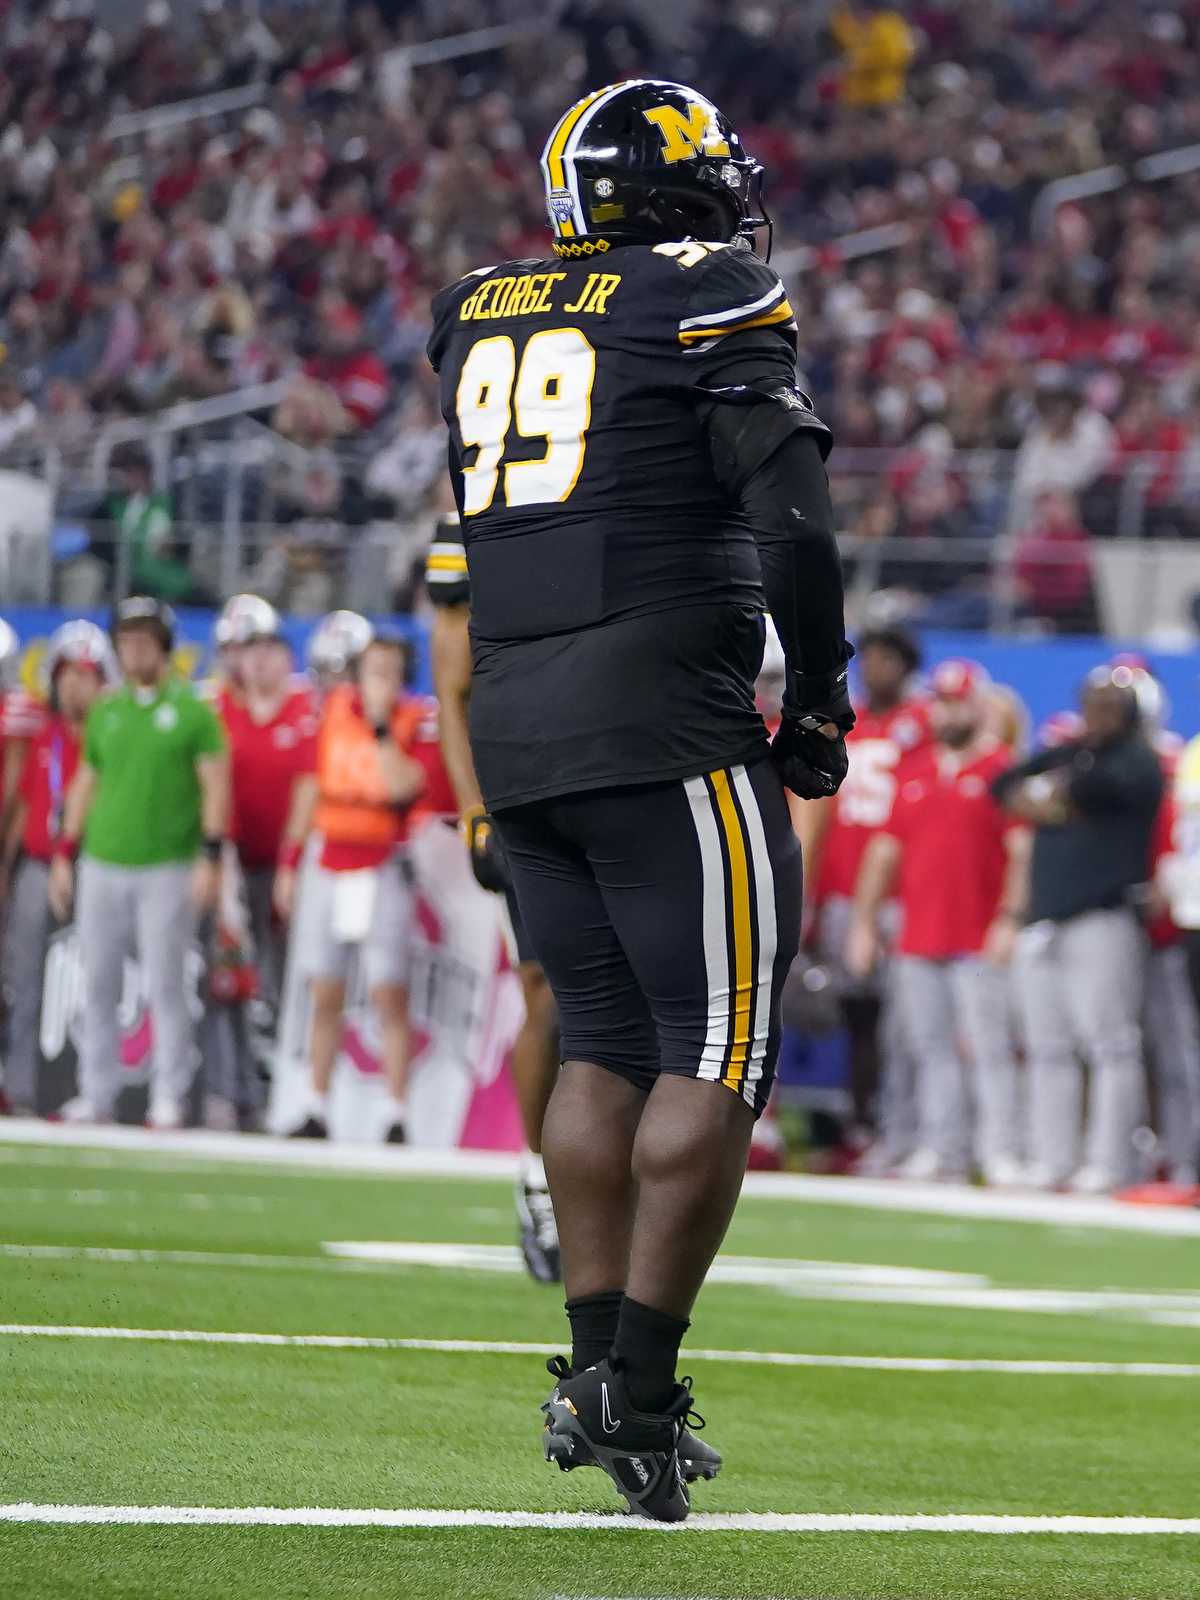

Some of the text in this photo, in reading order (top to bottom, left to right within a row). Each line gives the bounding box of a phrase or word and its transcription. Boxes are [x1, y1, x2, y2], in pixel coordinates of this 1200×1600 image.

[642, 103, 731, 164] M
[459, 272, 622, 321] GEORGE JR
[456, 327, 596, 516] 99
